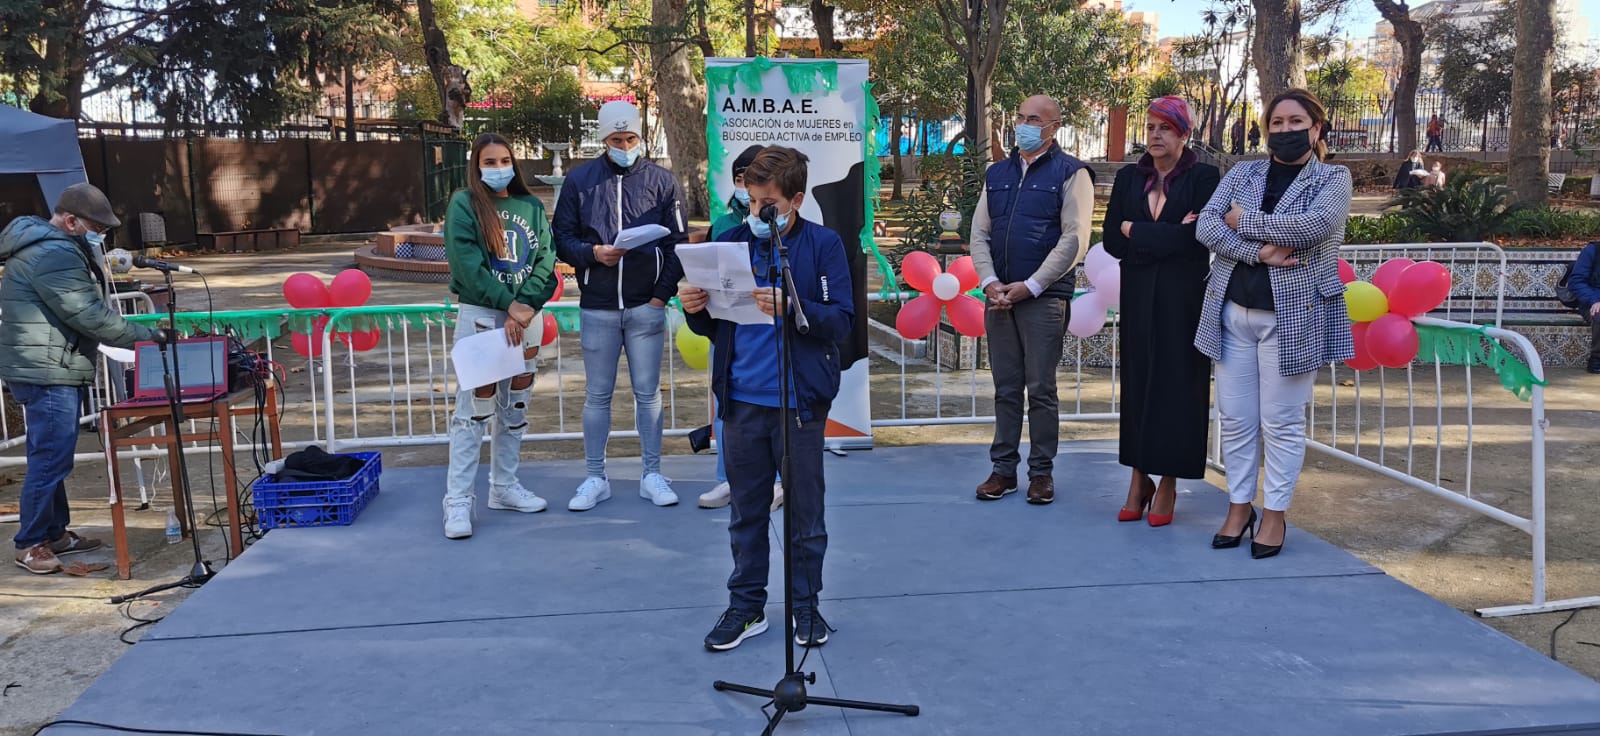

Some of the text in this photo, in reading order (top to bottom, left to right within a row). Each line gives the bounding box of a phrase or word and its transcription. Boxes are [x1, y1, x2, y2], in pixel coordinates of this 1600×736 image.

[722, 97, 818, 114] A.M.B.A.E.
[722, 117, 854, 129] ASOCIACIÓN de MUJERES en
[812, 132, 823, 142] de
[825, 132, 862, 142] EMPLEO
[512, 214, 539, 250] HEARTS
[820, 275, 830, 302] URBAN
